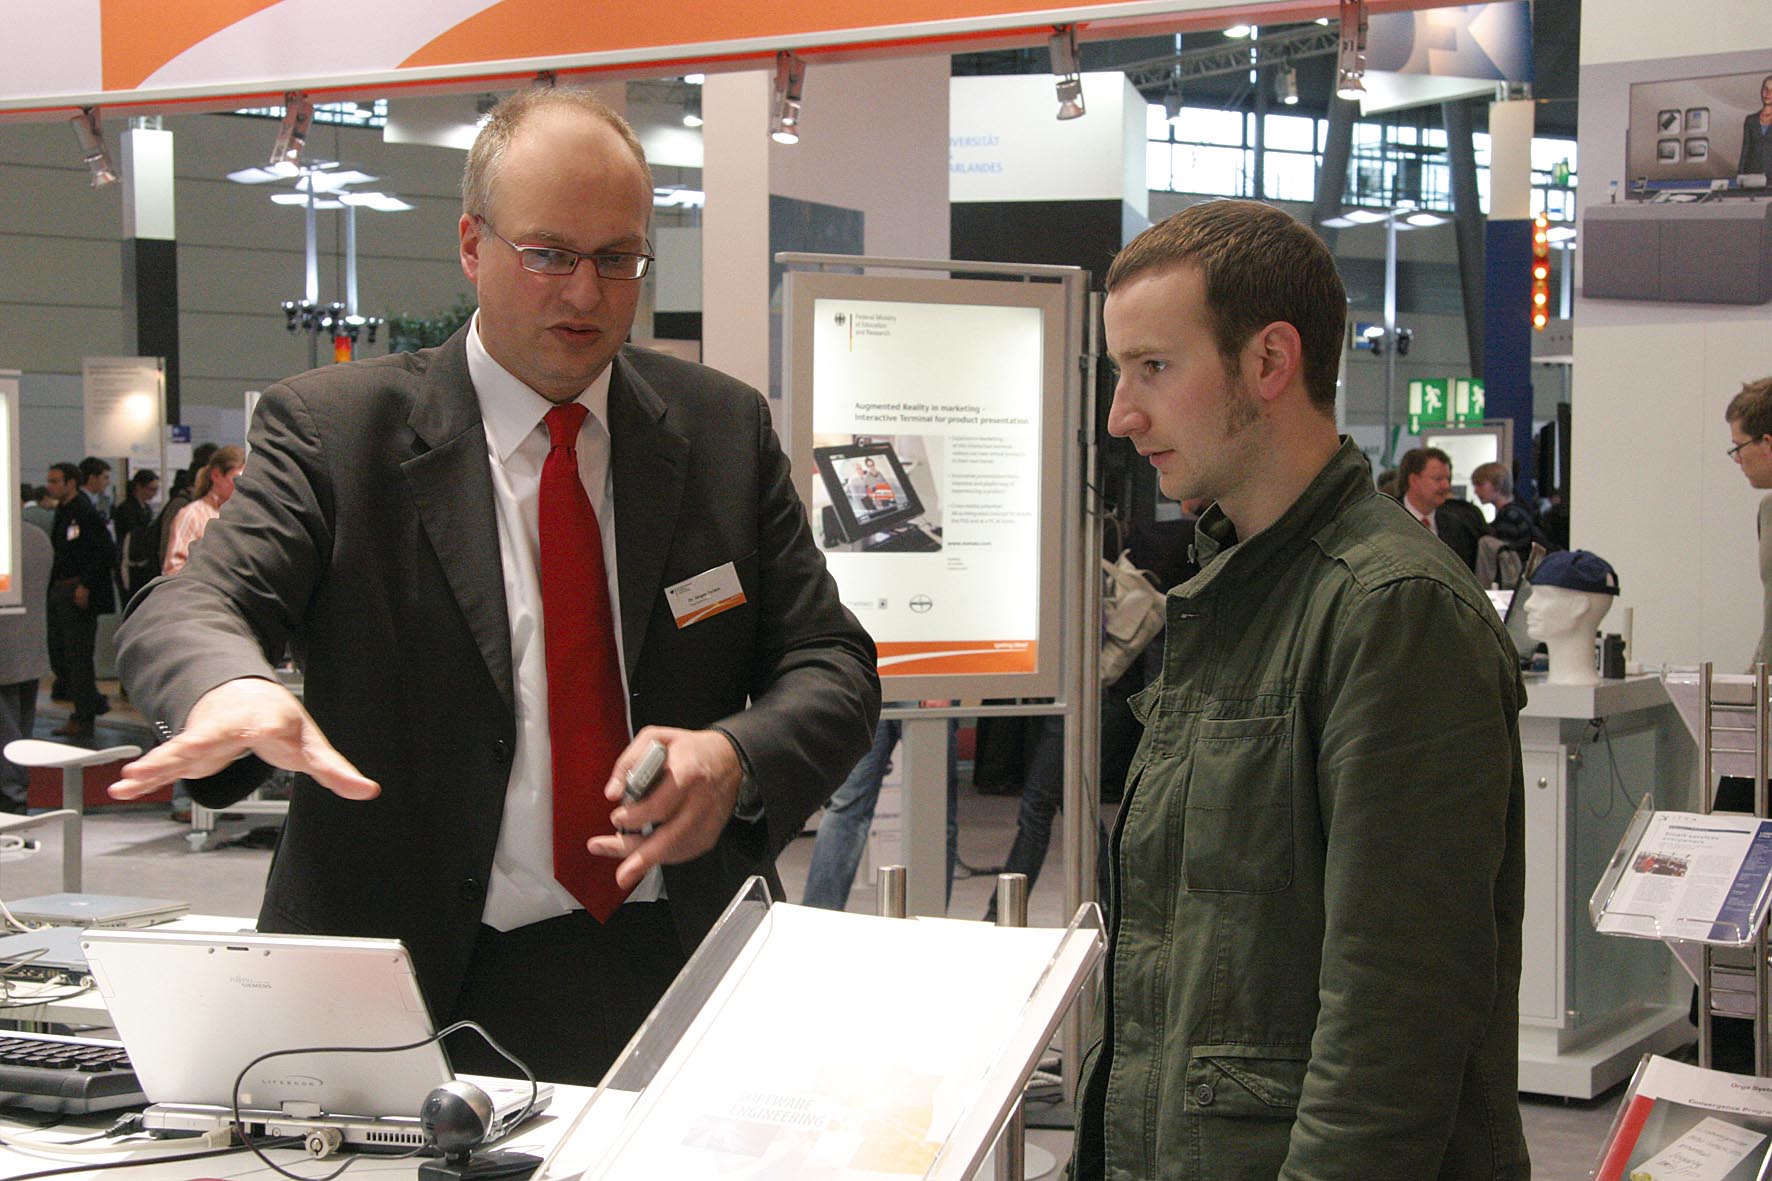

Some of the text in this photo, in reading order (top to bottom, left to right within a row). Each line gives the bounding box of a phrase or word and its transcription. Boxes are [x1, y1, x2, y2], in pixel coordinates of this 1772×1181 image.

[855, 402, 901, 413] Augmented
[902, 404, 930, 413] Reality
[940, 404, 981, 414] marketing
[854, 414, 1029, 426] Interactive Terminal for product presentation
[729, 1103, 826, 1127] ENGINEERING
